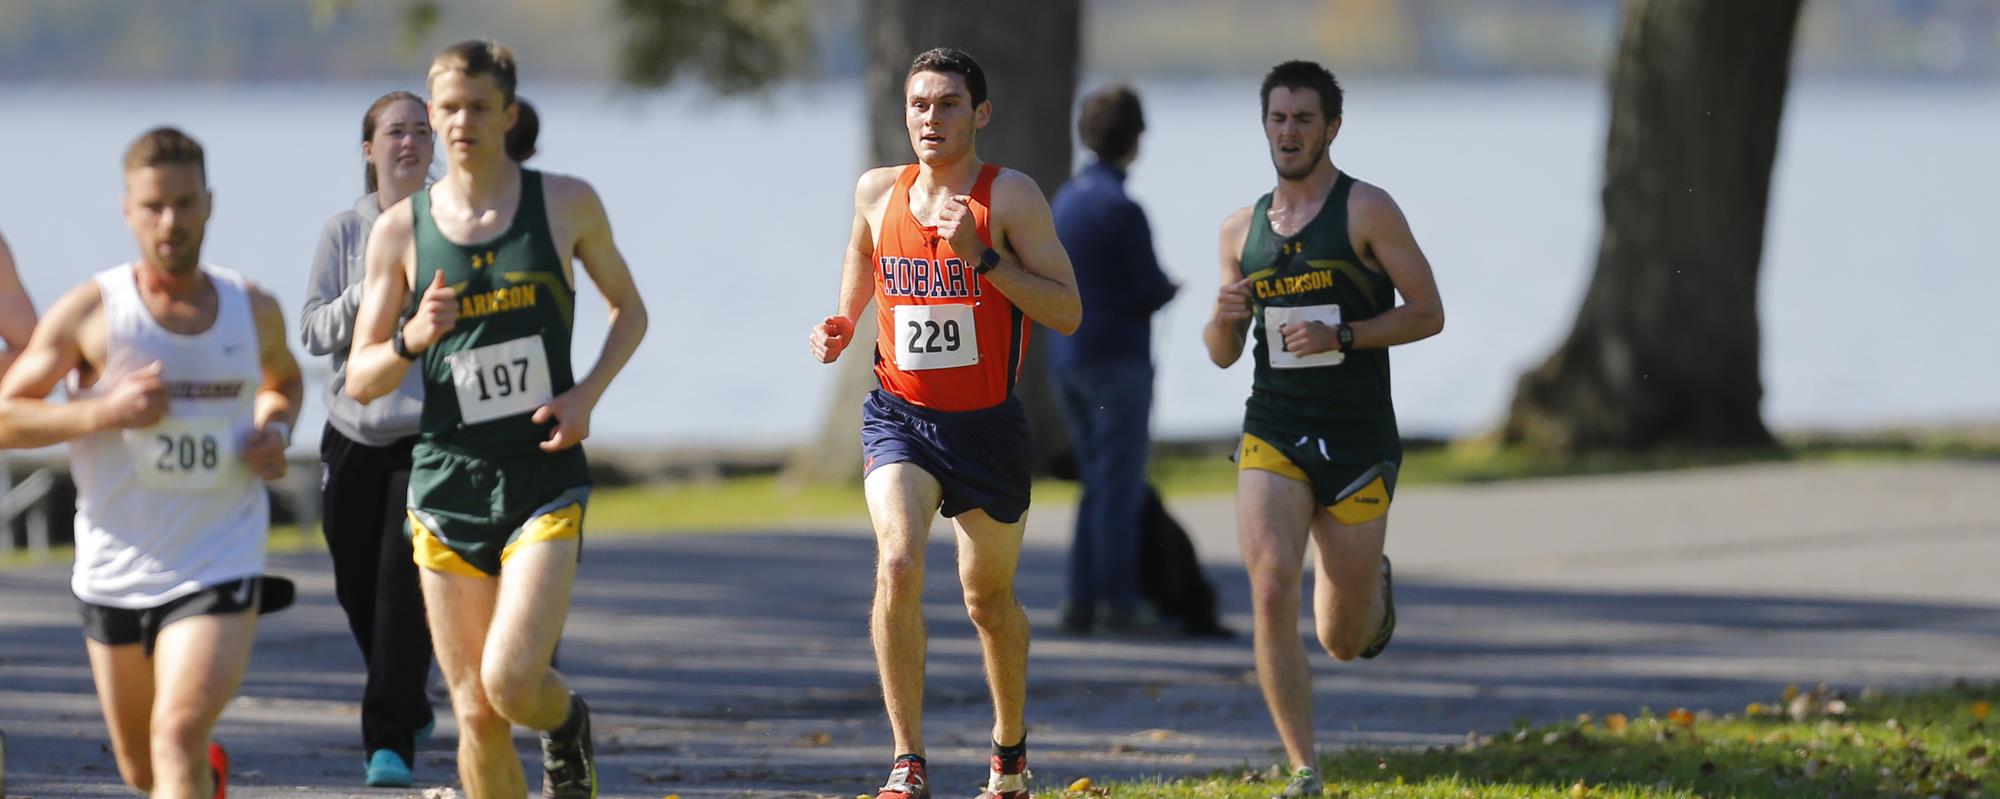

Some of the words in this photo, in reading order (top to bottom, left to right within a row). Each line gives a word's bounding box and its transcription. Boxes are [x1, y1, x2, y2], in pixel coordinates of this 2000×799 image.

[881, 257, 981, 298] HOBART
[1255, 269, 1333, 299] CLARKSON
[457, 284, 537, 318] ARKSON
[907, 319, 961, 354] 229
[475, 357, 529, 402] 197
[155, 433, 218, 472] 208
